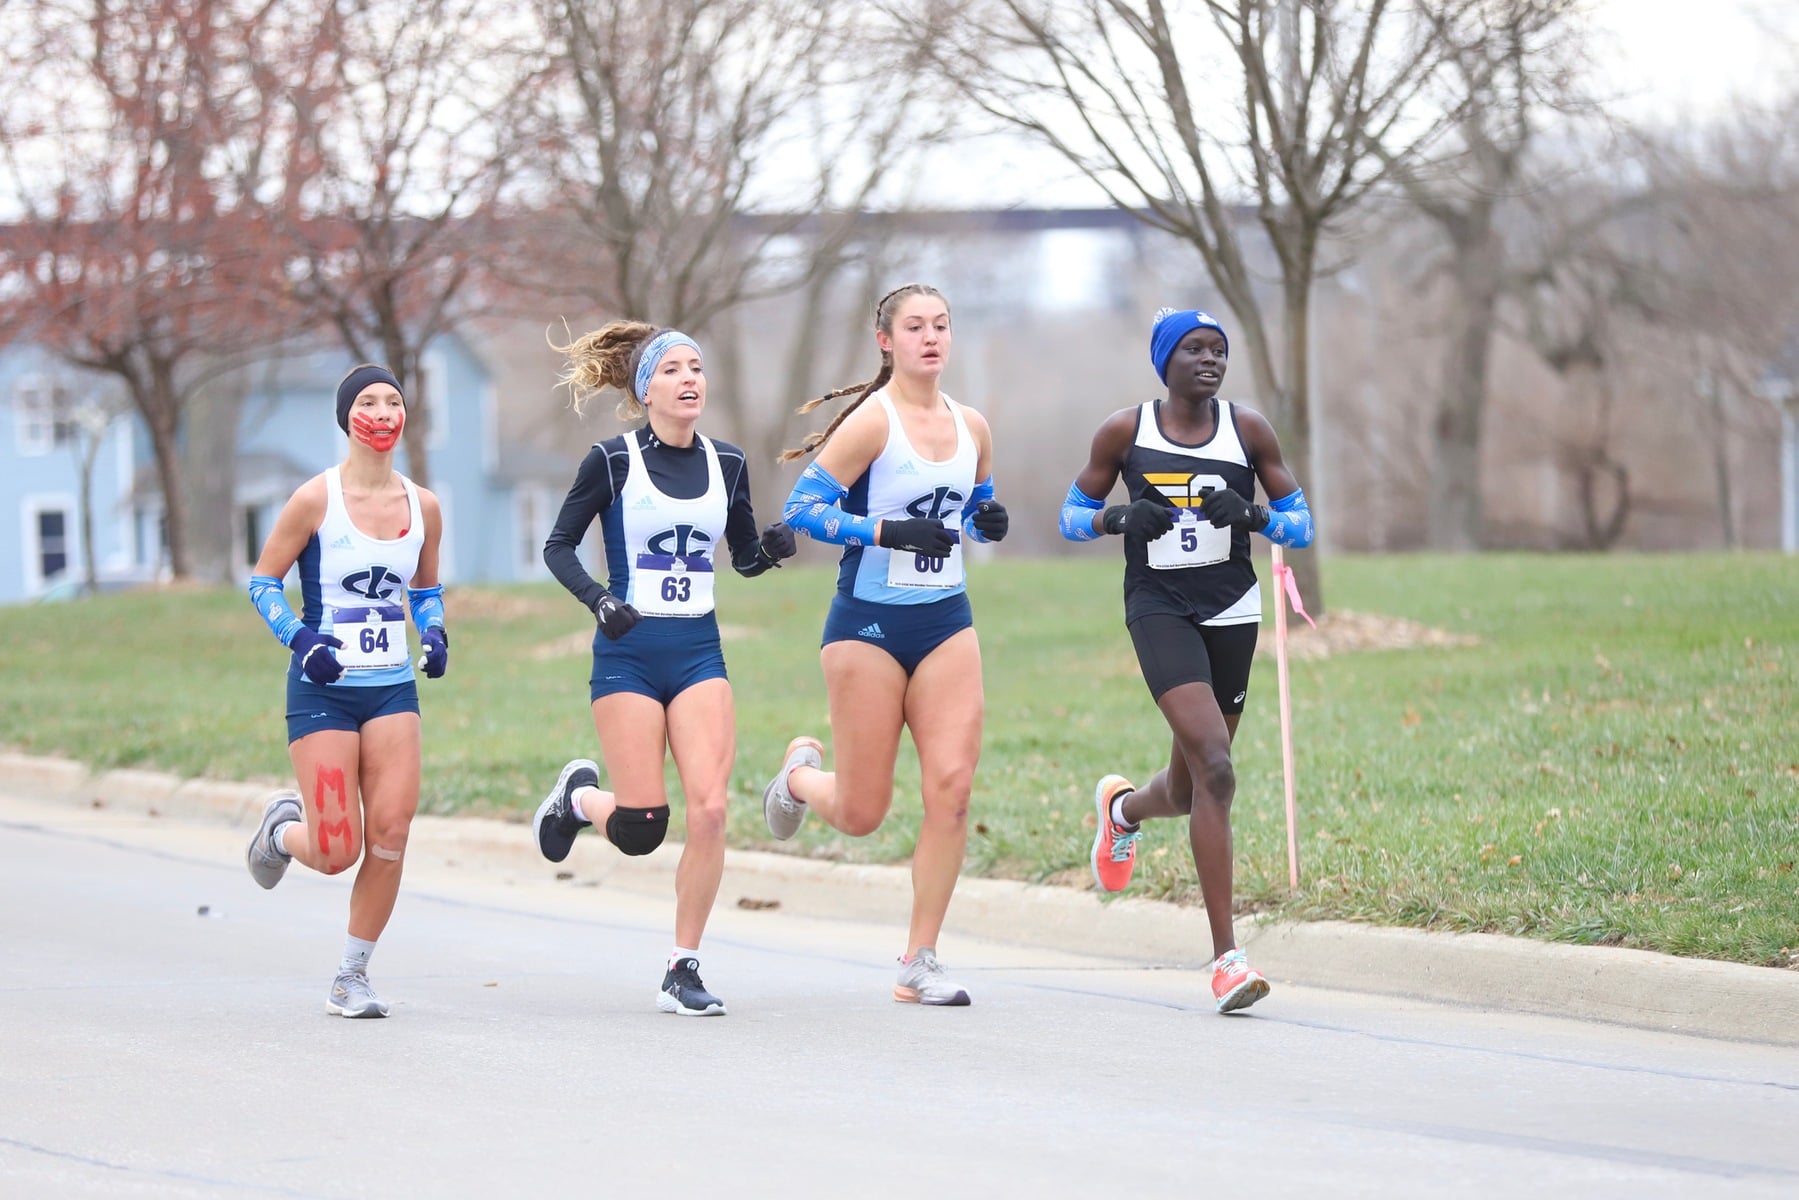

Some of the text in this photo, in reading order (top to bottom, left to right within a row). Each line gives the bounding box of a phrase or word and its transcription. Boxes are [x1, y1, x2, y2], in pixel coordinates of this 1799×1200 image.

[1181, 527, 1198, 552] 5
[914, 552, 944, 573] 60
[661, 576, 691, 602] 63
[360, 627, 389, 653] 64
